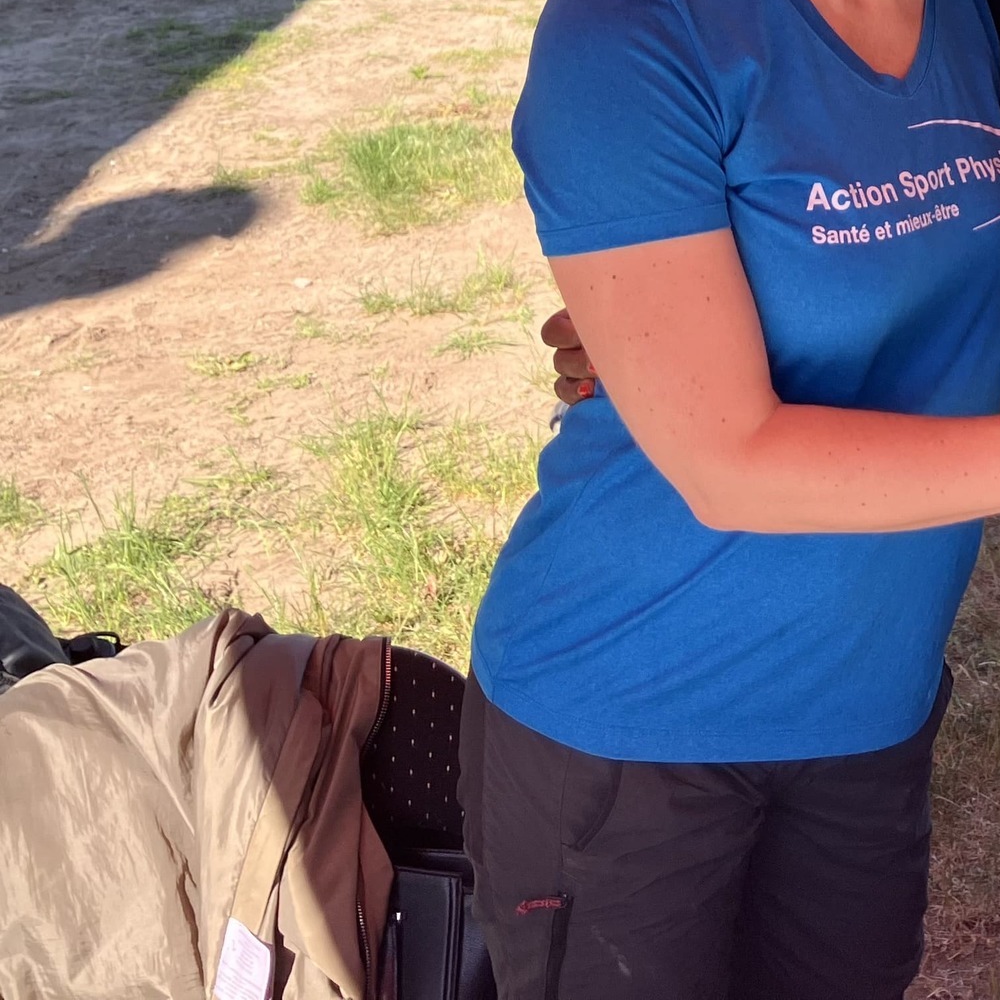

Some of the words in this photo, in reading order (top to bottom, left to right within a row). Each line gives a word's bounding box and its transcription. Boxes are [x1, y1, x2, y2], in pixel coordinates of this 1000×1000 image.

[806, 181, 899, 211] Action
[898, 162, 955, 200] Sport
[811, 223, 871, 244] Santé
[875, 221, 893, 241] et
[896, 203, 960, 236] mieux-être
